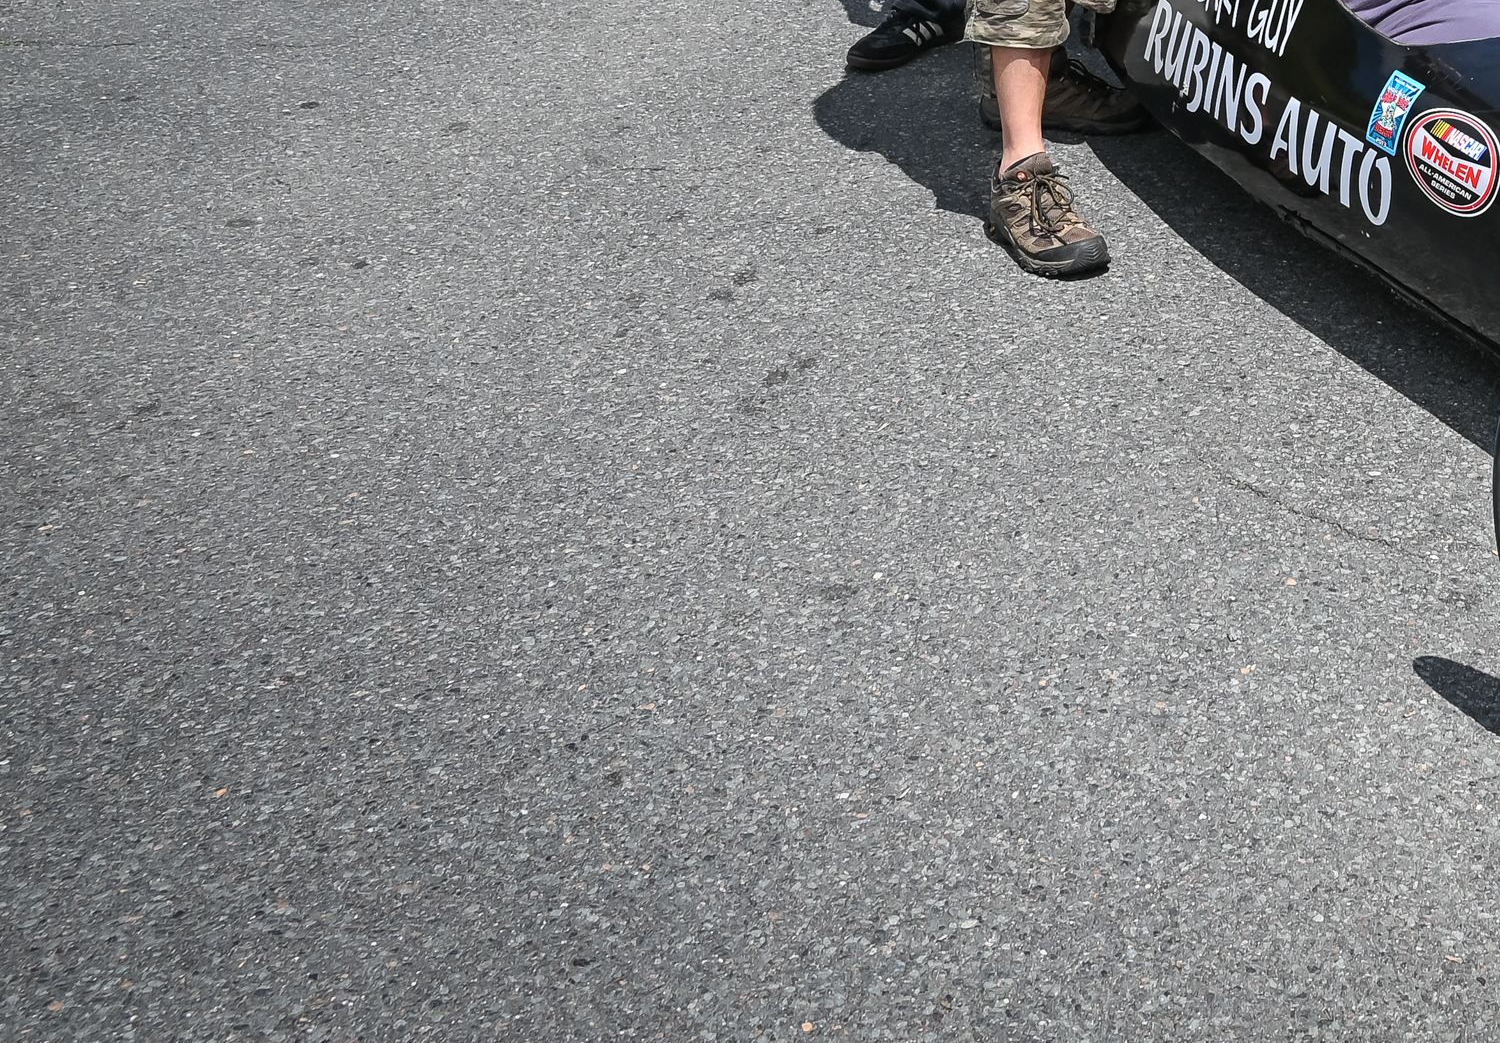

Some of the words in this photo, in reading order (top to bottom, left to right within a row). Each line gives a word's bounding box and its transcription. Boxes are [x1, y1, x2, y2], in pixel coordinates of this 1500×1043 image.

[1269, 95, 1394, 227] AUTO
[1422, 135, 1482, 189] WHELEN
[1445, 128, 1487, 161] NASCAR
[1418, 163, 1472, 201] ALL-AMERICAN
[1430, 179, 1456, 200] SERIES
